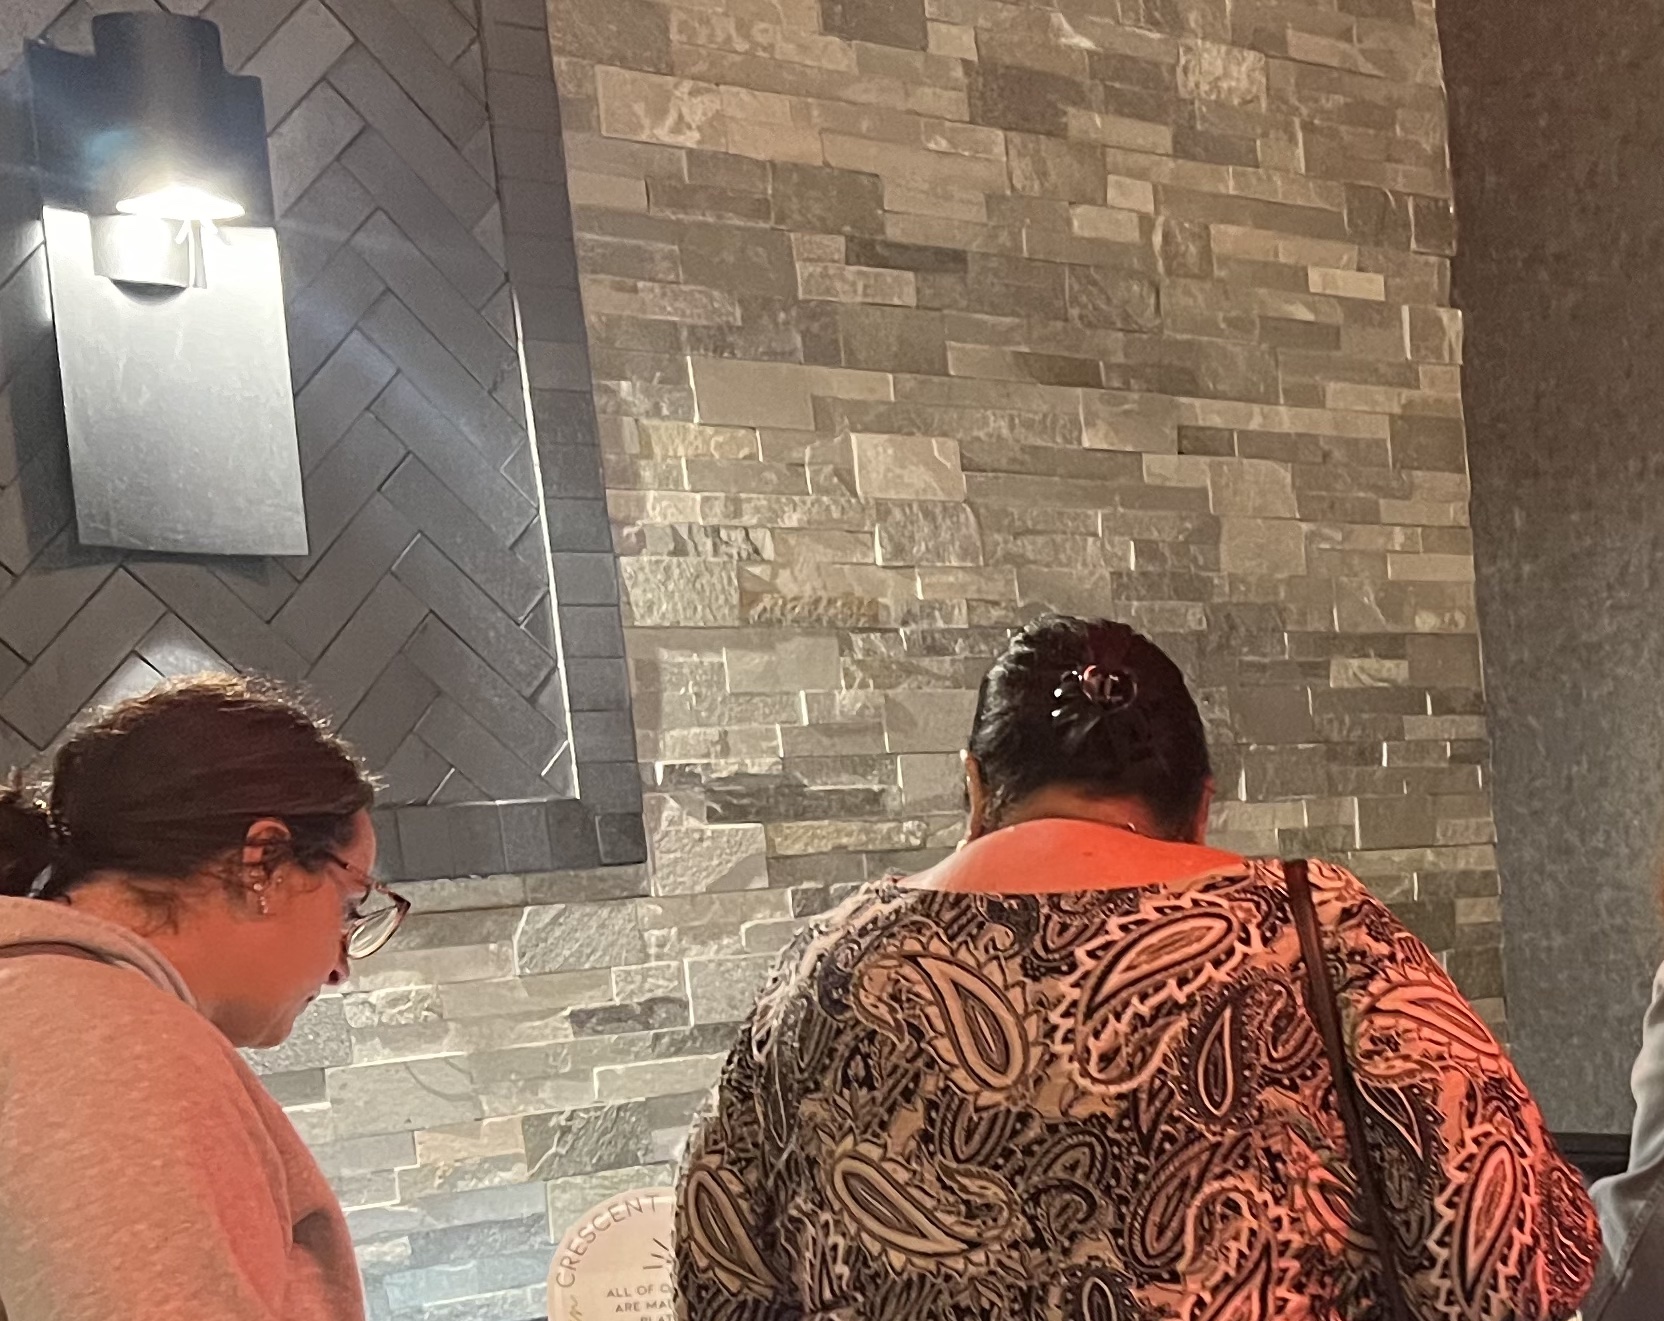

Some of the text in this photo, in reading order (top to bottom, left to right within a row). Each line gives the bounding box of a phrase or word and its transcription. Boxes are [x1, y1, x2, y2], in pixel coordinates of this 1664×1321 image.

[556, 1195, 660, 1289] CRESCENT
[607, 1288, 632, 1298] ALL
[636, 1284, 654, 1296] OF
[615, 1301, 641, 1313] ARE
